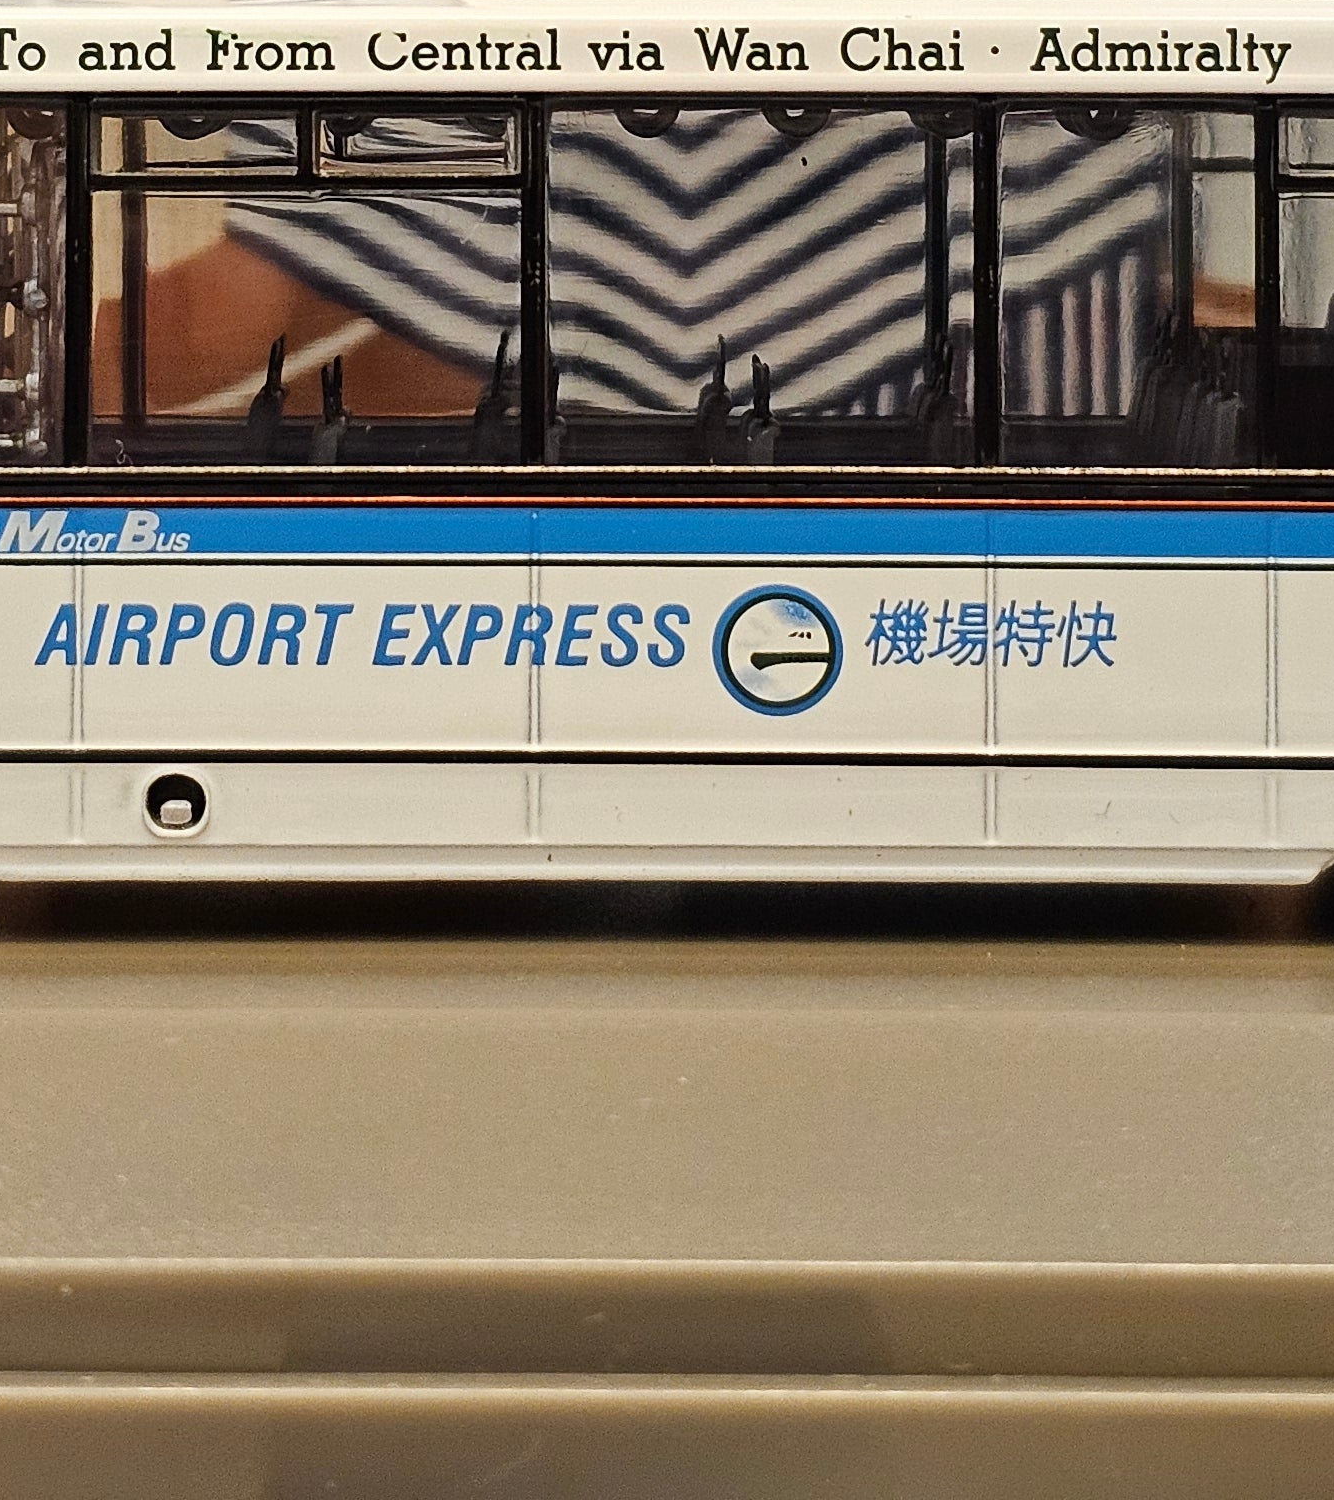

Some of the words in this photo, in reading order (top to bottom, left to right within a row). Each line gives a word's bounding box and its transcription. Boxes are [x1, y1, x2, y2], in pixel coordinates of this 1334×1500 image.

[78, 28, 176, 72] and
[205, 28, 336, 72] From
[367, 27, 562, 71] Central
[587, 30, 665, 72] via
[693, 27, 810, 72] Wan
[840, 27, 965, 72] Chai
[1029, 27, 1292, 85] Admiralty
[117, 509, 191, 553] Bus
[35, 602, 354, 667] AIRPORT
[372, 603, 691, 668] EXPRESS
[865, 599, 1117, 668] 機場特快
